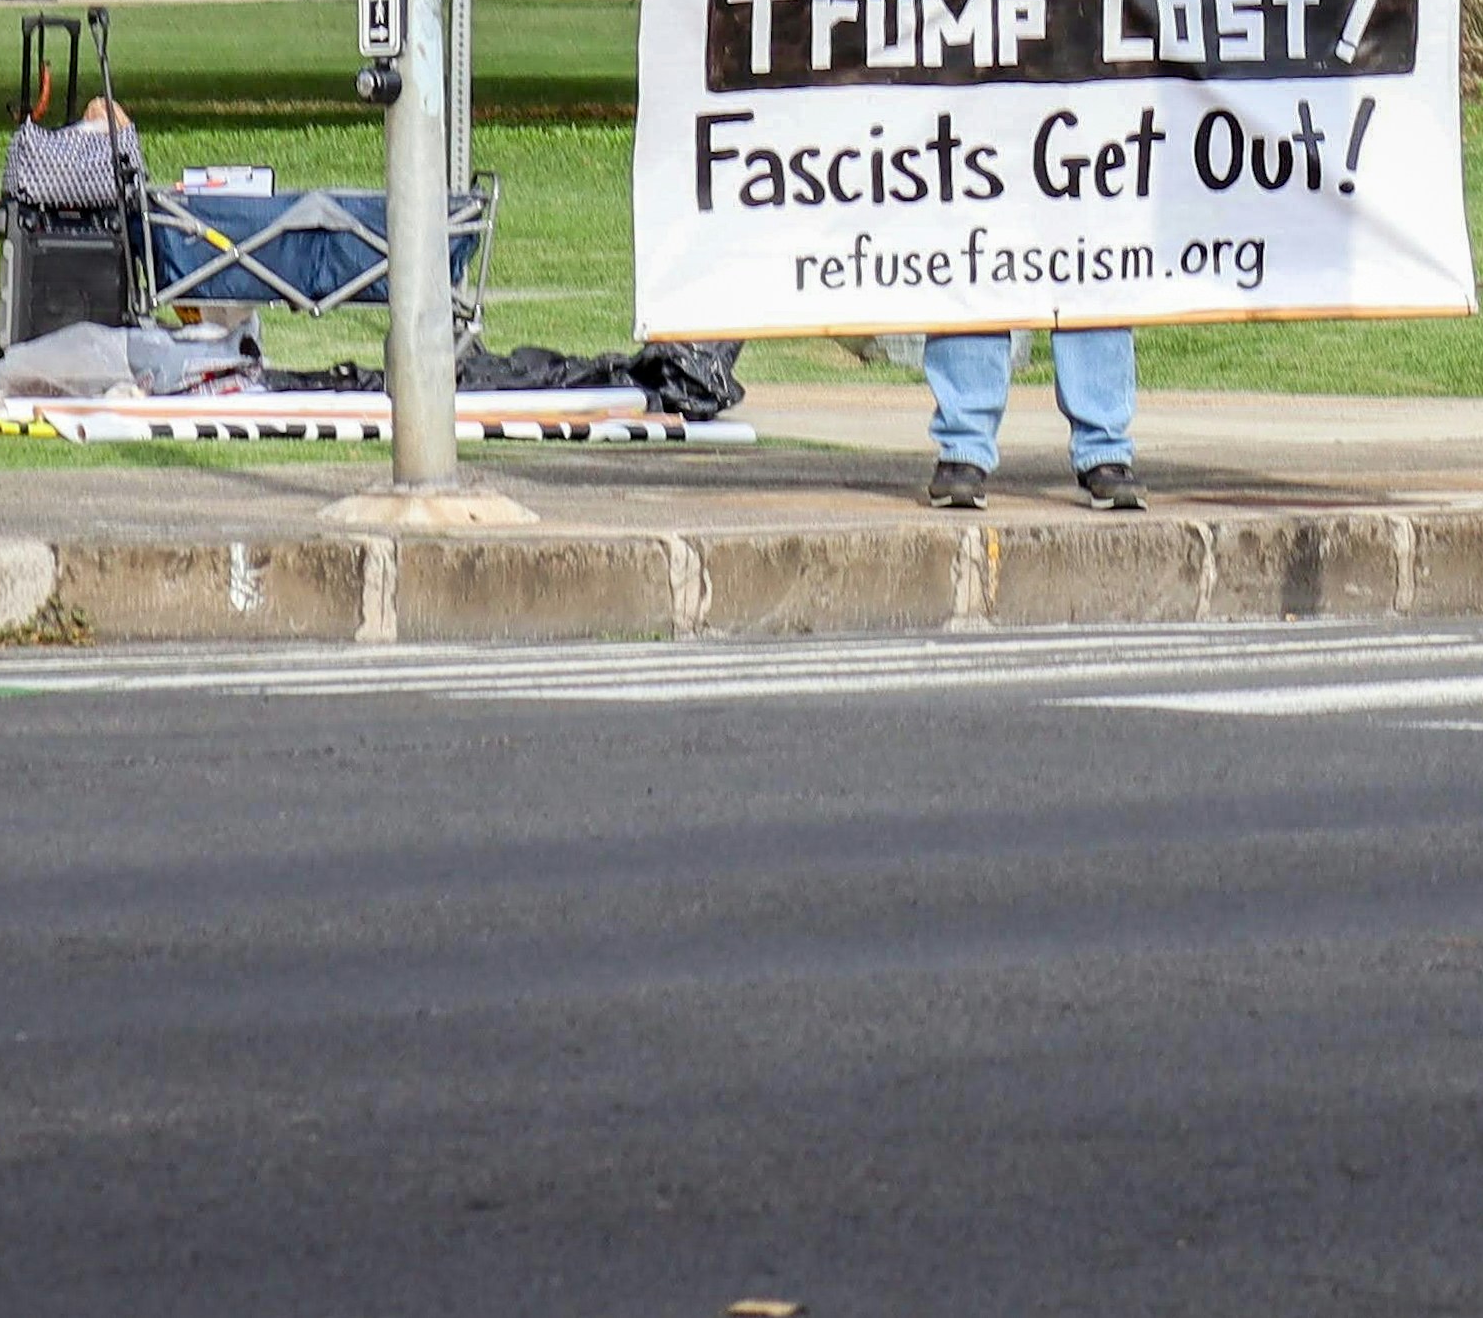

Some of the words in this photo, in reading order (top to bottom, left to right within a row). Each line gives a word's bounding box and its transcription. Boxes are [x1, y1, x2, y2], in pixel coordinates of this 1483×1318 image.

[695, 107, 1006, 213] Fascists
[1033, 106, 1166, 200] Get
[1194, 96, 1376, 197] Out!
[793, 226, 1267, 293] refusefascism.org
